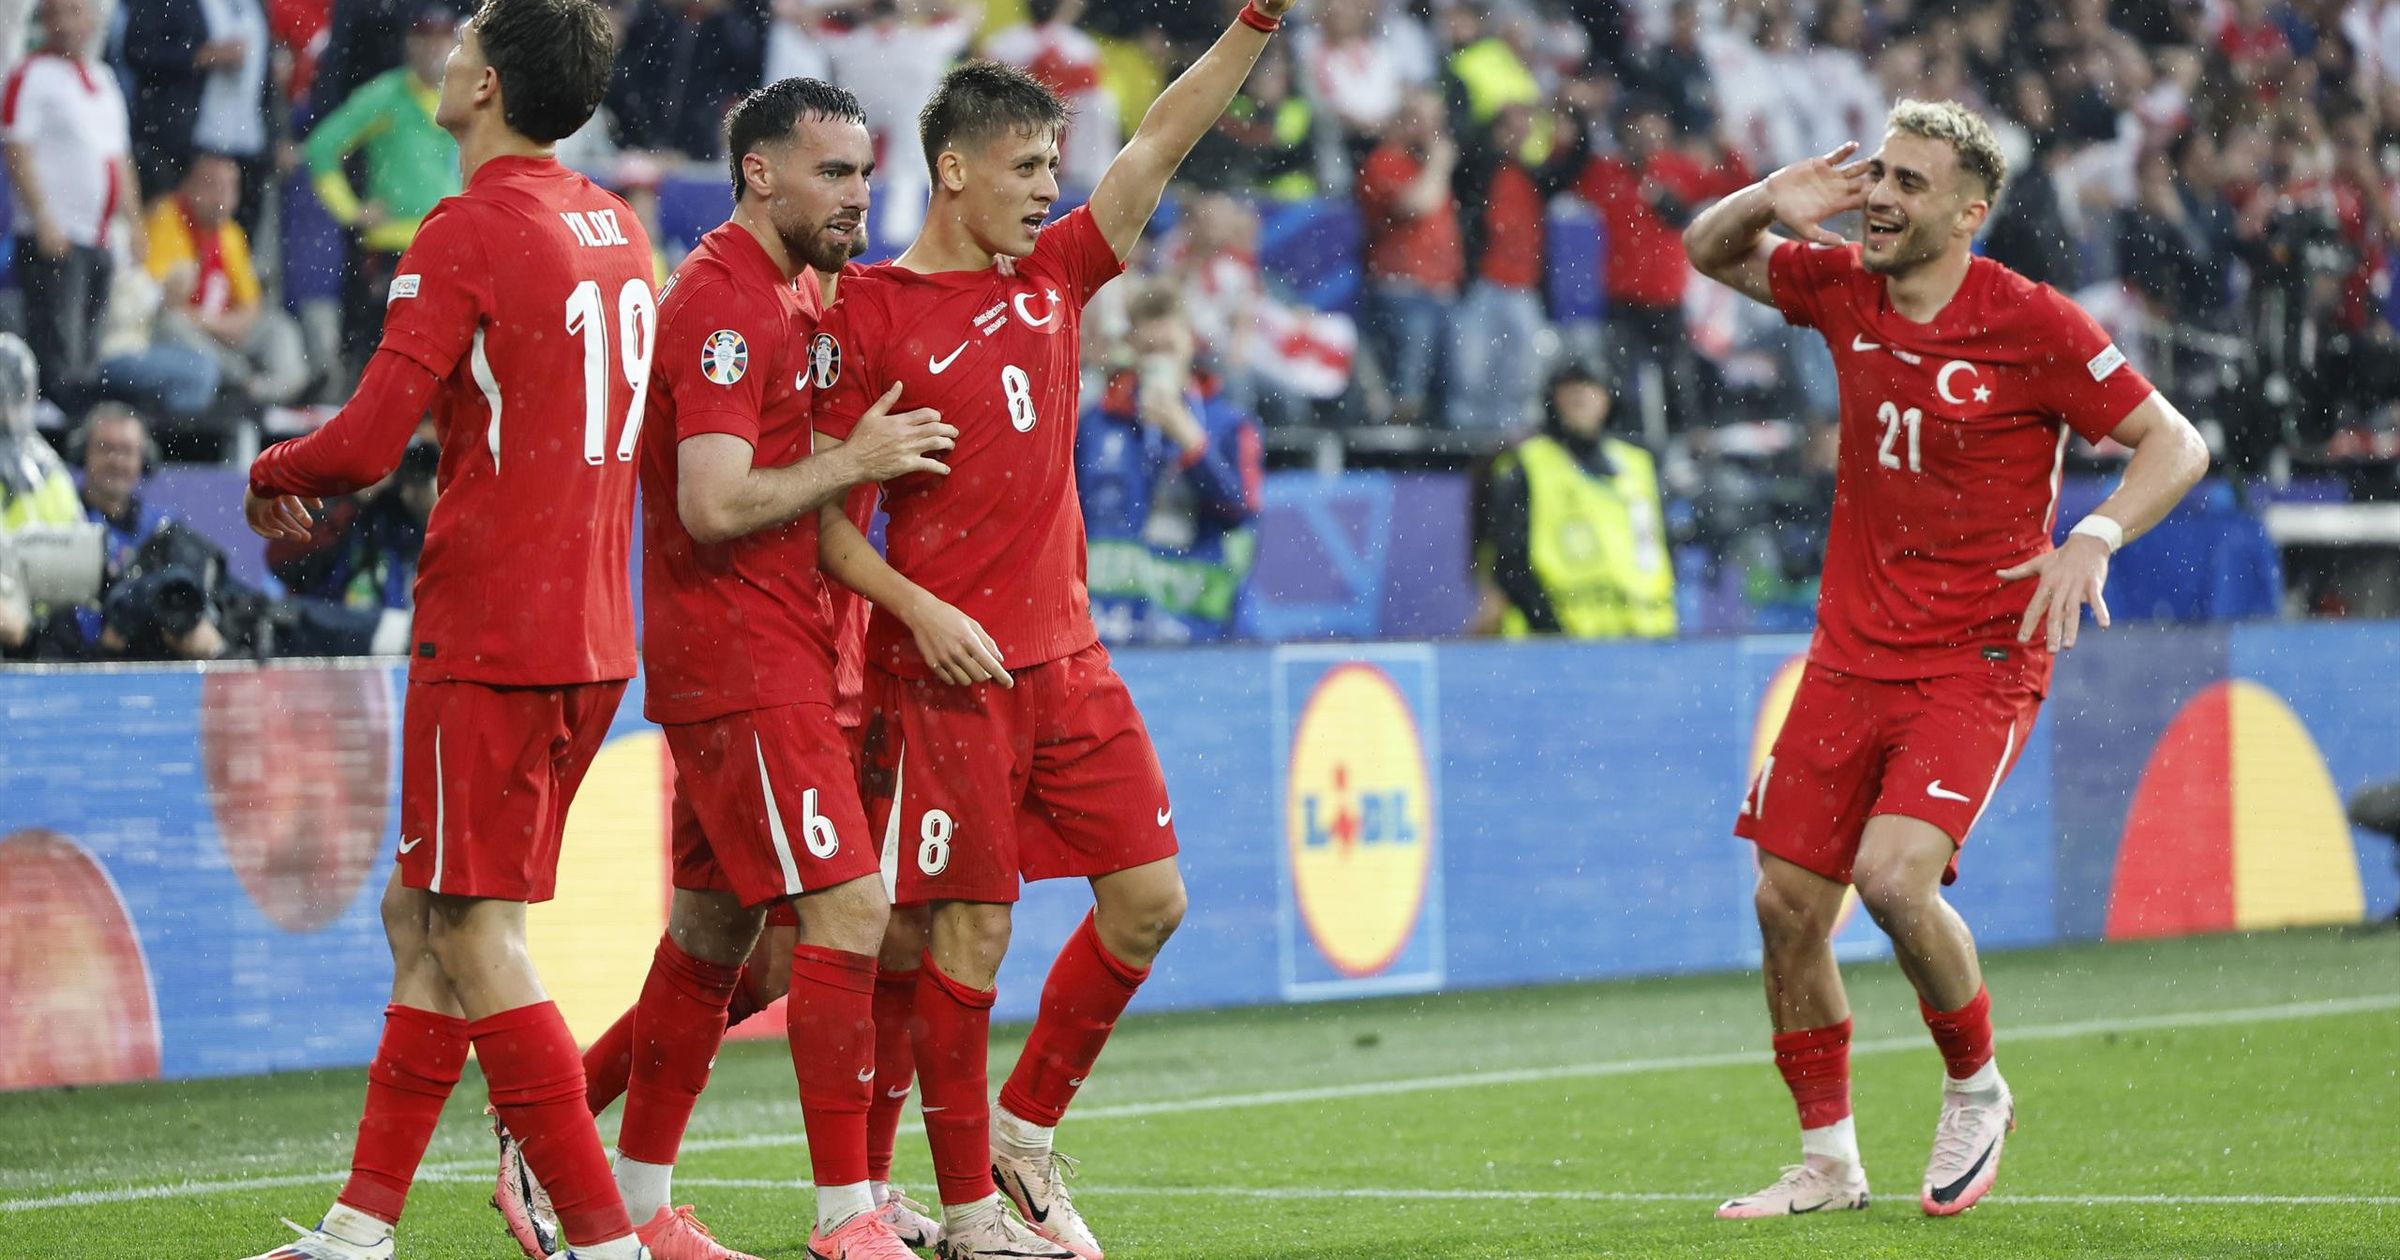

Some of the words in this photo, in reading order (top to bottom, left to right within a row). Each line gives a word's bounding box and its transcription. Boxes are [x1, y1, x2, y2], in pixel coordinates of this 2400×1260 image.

[560, 208, 629, 247] YILDIZ
[565, 277, 657, 465] 19
[1001, 364, 1037, 433] 8
[1876, 400, 1922, 473] 21
[802, 787, 840, 859] 6
[917, 808, 953, 876] 8
